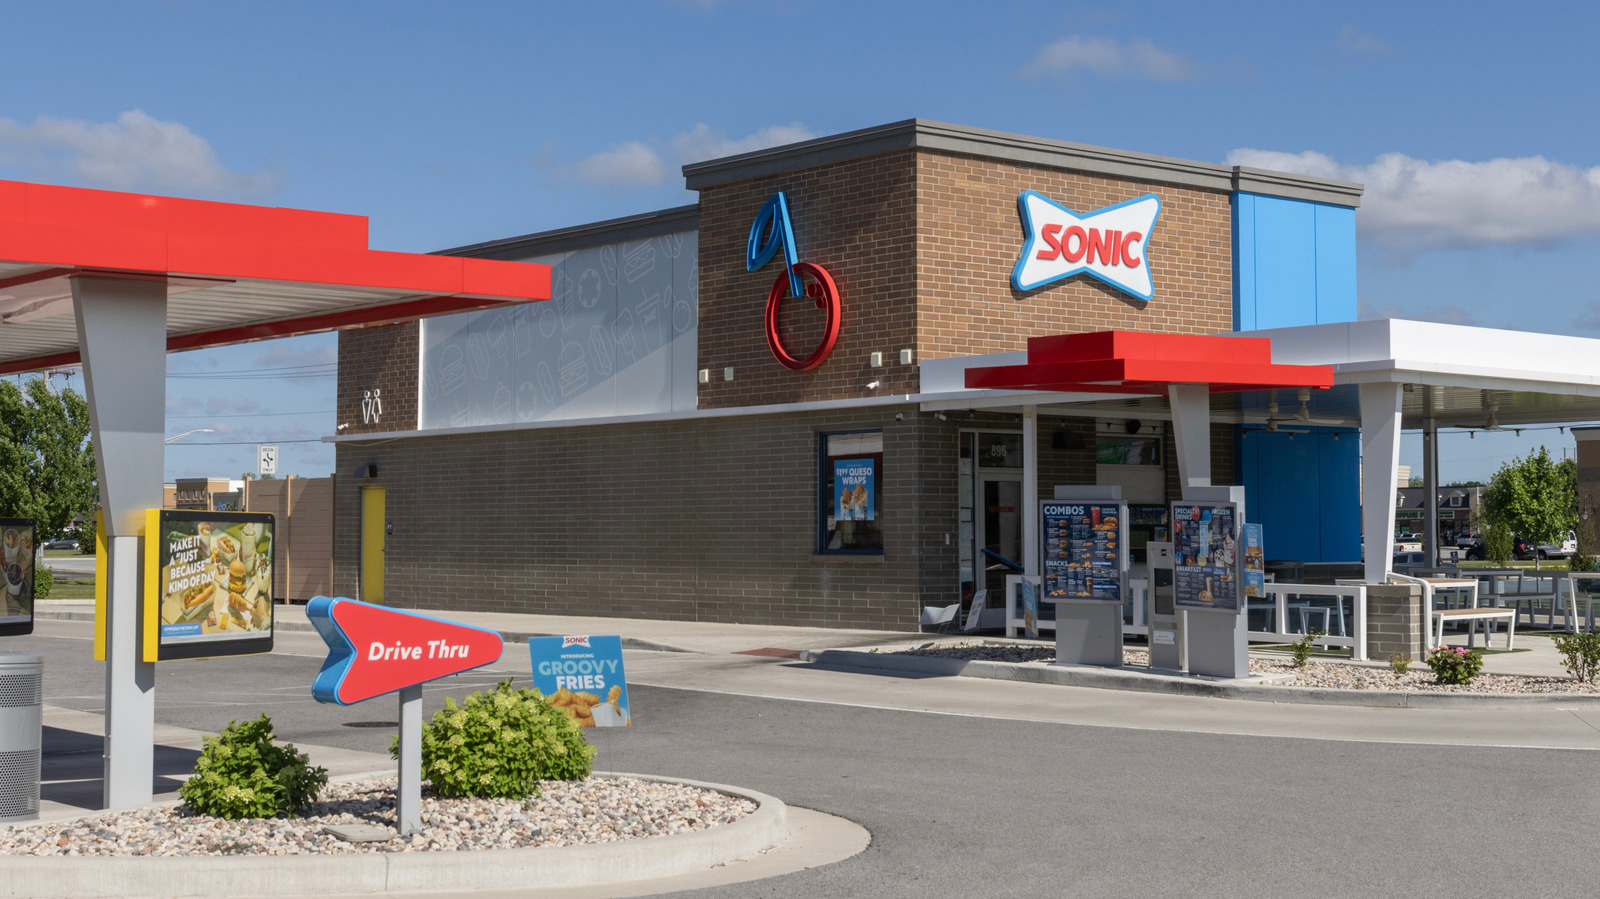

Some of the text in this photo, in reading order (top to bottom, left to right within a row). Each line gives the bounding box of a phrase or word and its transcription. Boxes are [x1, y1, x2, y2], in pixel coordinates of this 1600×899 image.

[1036, 223, 1143, 268] SONIC
[991, 444, 1007, 457] 896
[848, 467, 873, 476] QUESO
[841, 476, 867, 485] WRAPS
[1044, 505, 1085, 515] COMBOS
[1174, 507, 1199, 515] SPECIALTY
[169, 534, 202, 553] MAKE IT
[169, 555, 176, 567] A
[168, 570, 216, 594] KIND OF DAY
[565, 636, 588, 644] SONIC
[368, 639, 470, 661] Drive Thru
[538, 659, 619, 676] GROOVY
[556, 674, 606, 690] FRIES
